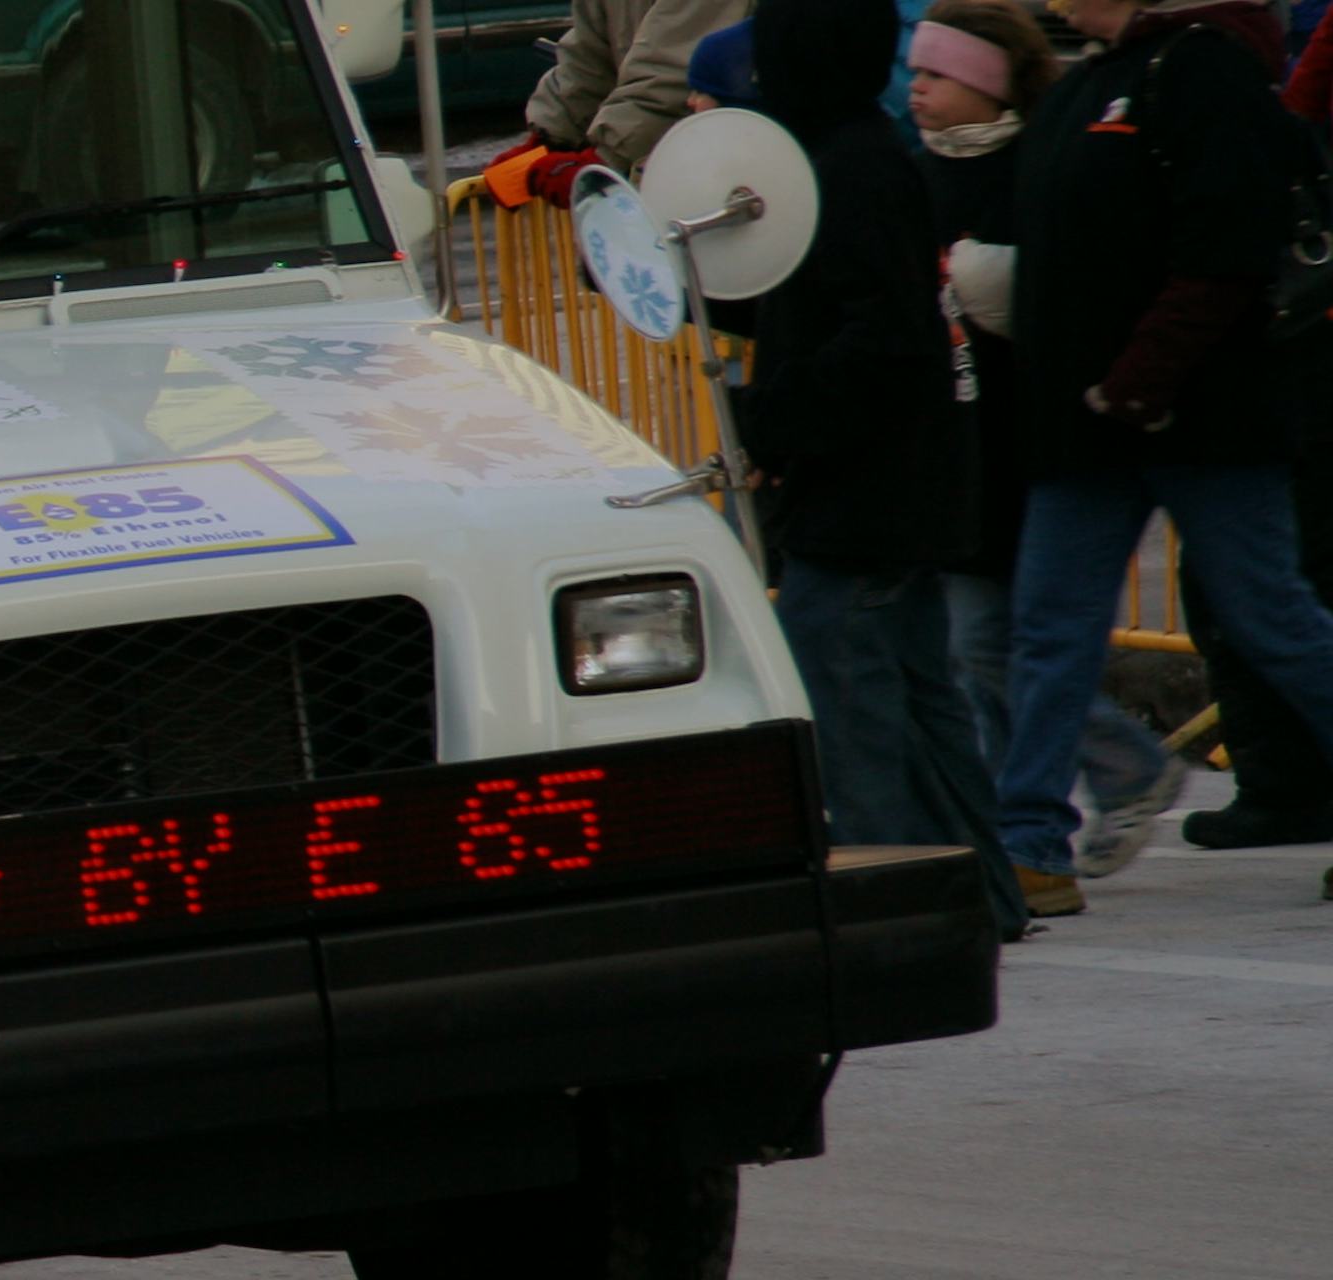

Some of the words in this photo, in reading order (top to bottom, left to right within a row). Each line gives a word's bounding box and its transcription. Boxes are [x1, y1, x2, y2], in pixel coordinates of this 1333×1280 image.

[53, 477, 97, 487] Fuel
[100, 471, 169, 483] Choice
[9, 553, 43, 565] For
[47, 541, 127, 561] Flexible
[131, 537, 175, 550] Fuel
[181, 527, 266, 545] Vehicles
[13, 530, 83, 546] 85%
[90, 512, 228, 536] Ethanol
[78, 811, 234, 928] BY
[305, 794, 383, 901] E
[455, 767, 607, 881] 85
